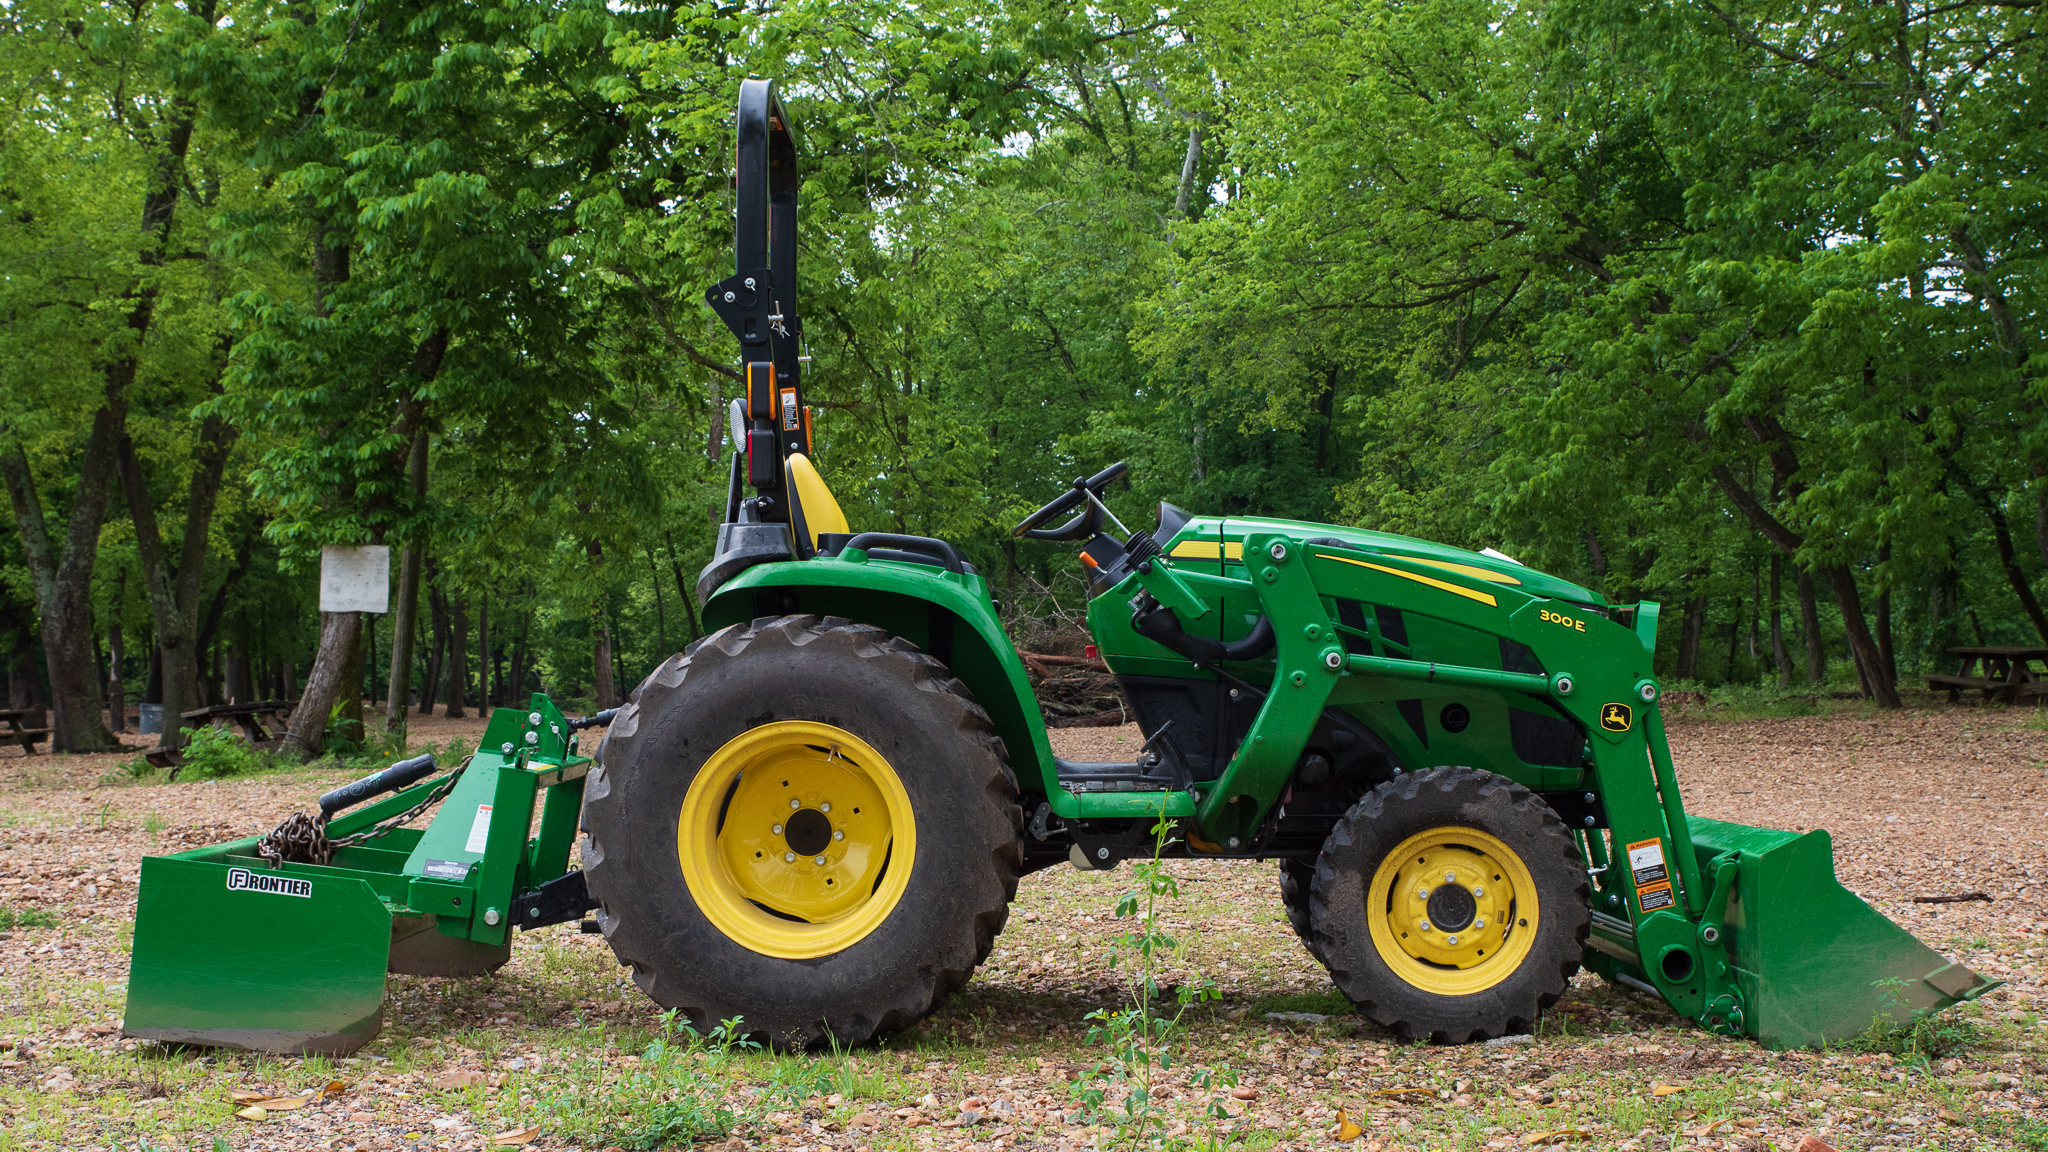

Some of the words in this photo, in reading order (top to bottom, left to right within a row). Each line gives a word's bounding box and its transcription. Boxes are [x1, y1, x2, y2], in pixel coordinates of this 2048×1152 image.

[1635, 839, 1657, 848] WARNING
[228, 869, 311, 896] FRONTIER
[1646, 883, 1668, 892] WARNING
